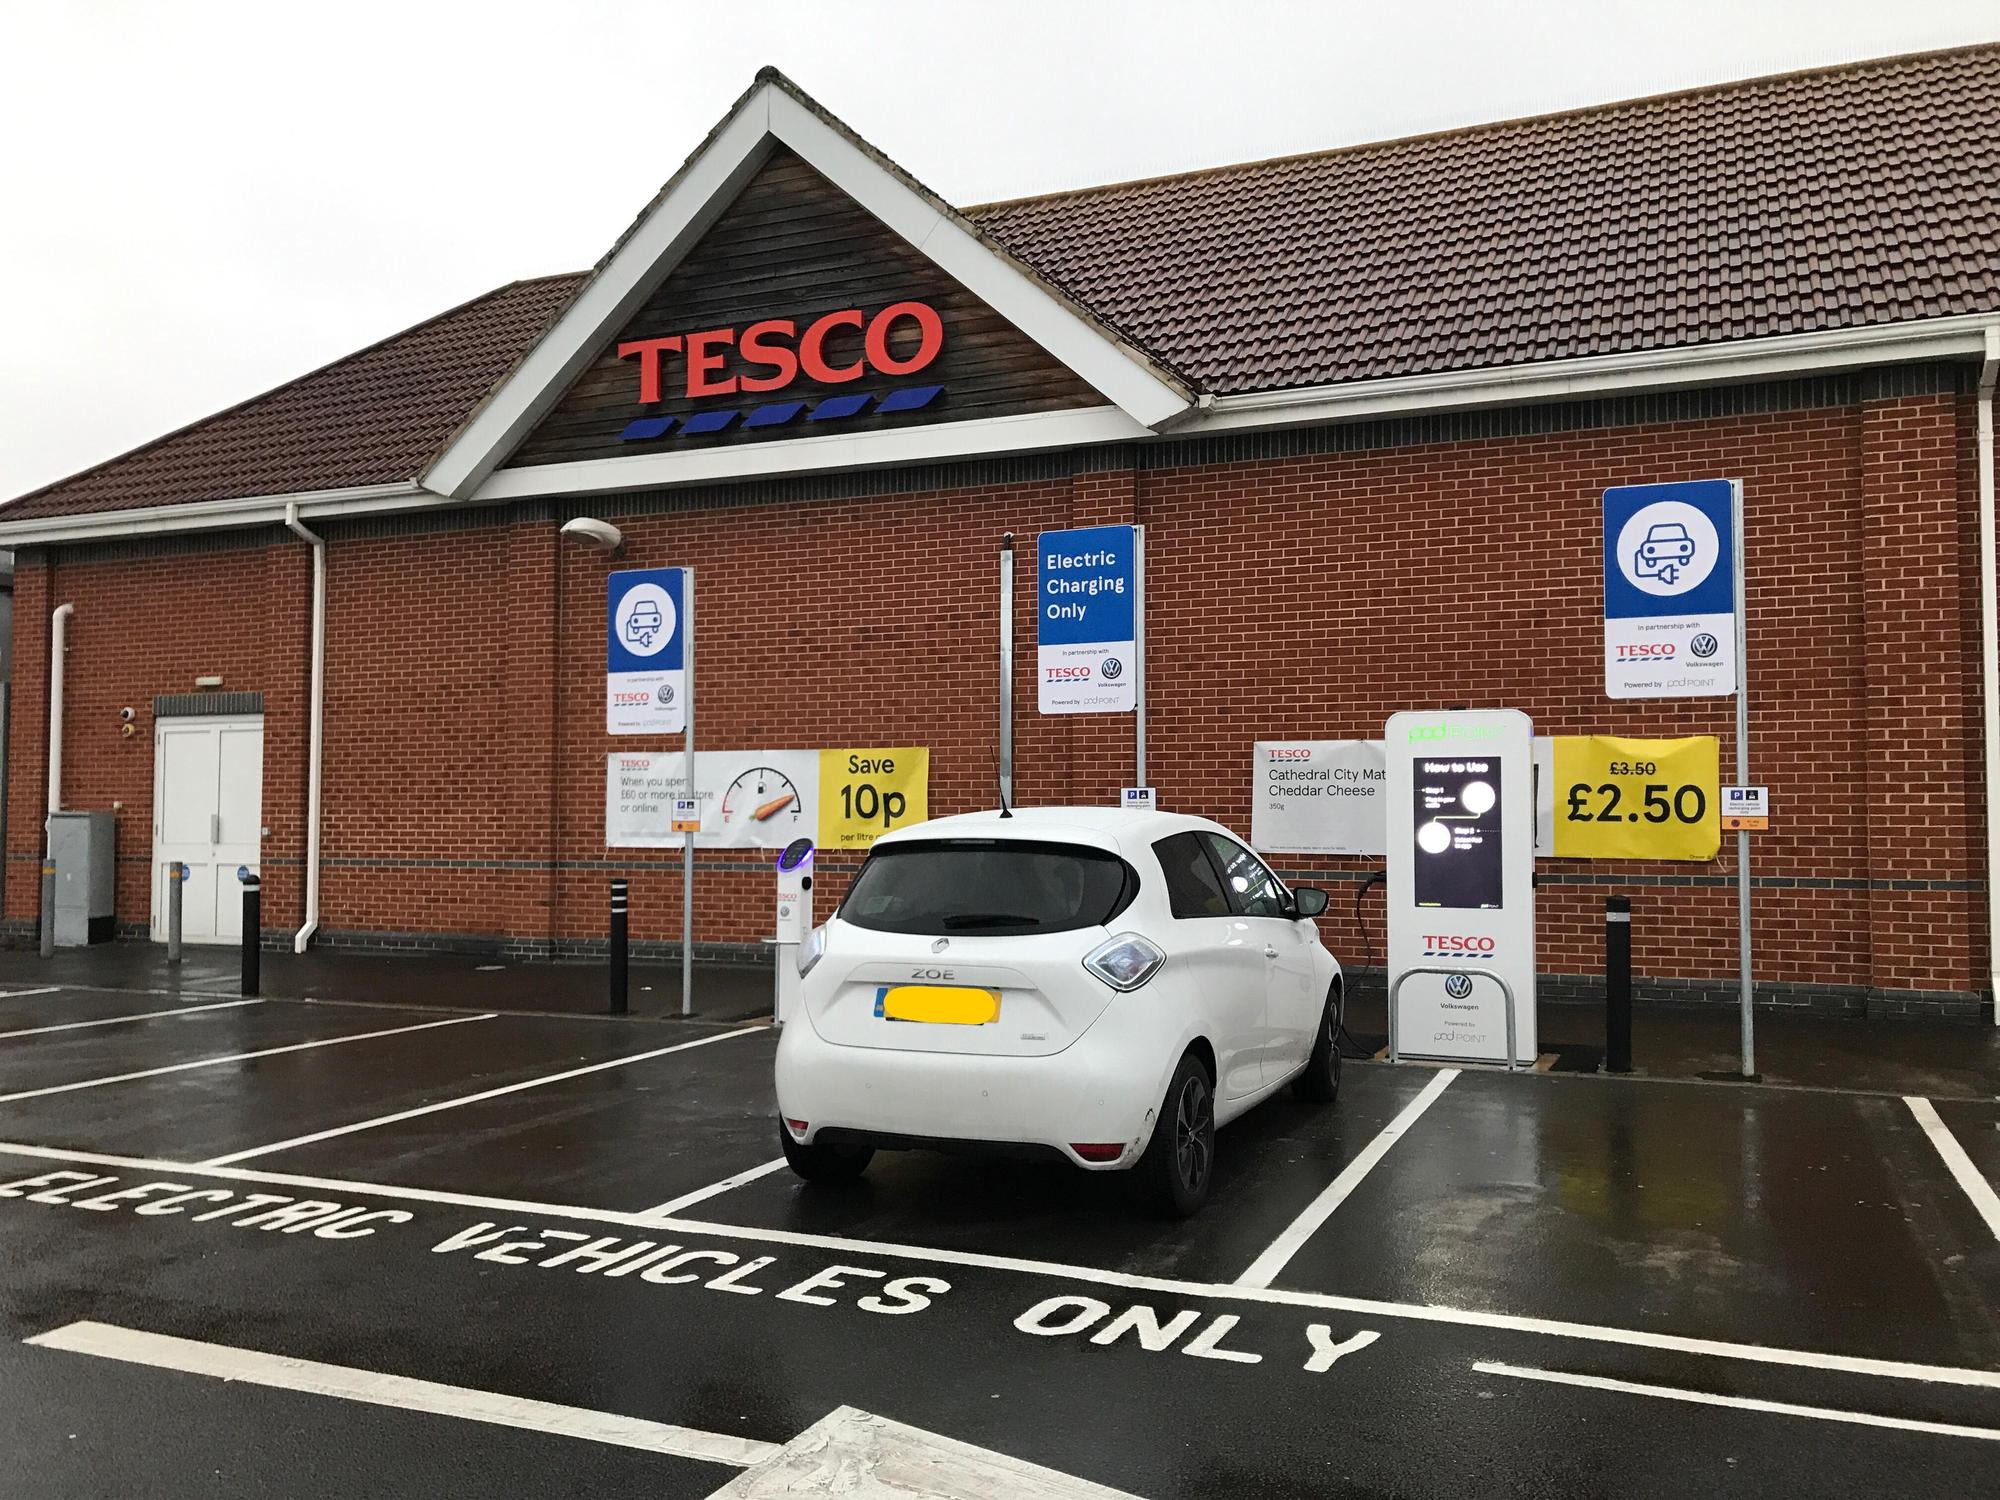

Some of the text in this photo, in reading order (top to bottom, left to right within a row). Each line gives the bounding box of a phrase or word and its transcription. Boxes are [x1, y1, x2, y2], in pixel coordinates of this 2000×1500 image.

[617, 301, 944, 404] TESCO
[1047, 550, 1116, 570] Electric
[1046, 575, 1125, 596] Charging
[1046, 602, 1087, 622] Only
[1645, 623, 1685, 631] partnership
[1068, 649, 1098, 657] partnership
[1616, 643, 1676, 657] TESCO
[1046, 666, 1091, 678] TESCO
[1624, 681, 1653, 689] Powered
[1654, 681, 1663, 689] by
[613, 692, 650, 702] TESCO
[1074, 698, 1080, 706] by
[1268, 749, 1312, 759] TESCO
[620, 759, 650, 768] TESCO
[848, 754, 895, 774] Save
[1609, 761, 1657, 776] £3.50
[1268, 769, 1330, 781] Cathedral
[1333, 768, 1359, 783] City
[620, 777, 645, 786] When
[646, 778, 663, 788] you
[620, 790, 637, 800] £60
[638, 792, 648, 800] or
[650, 792, 676, 800] more
[1268, 784, 1376, 796] Cheddar Cheese
[620, 803, 659, 813] or online
[840, 783, 906, 828] 10p
[1268, 803, 1285, 812] 350g
[1567, 783, 1706, 825] £2.50
[793, 815, 798, 823] F
[840, 834, 855, 842] per
[857, 833, 874, 841] litre
[1422, 935, 1496, 951] TESCO
[911, 968, 955, 980] ZOE
[1440, 1003, 1480, 1011] Volkswagen
[1455, 1033, 1488, 1043] POINT
[0, 1170, 1382, 1373] ELECTRIC VEHICLES ONLY
